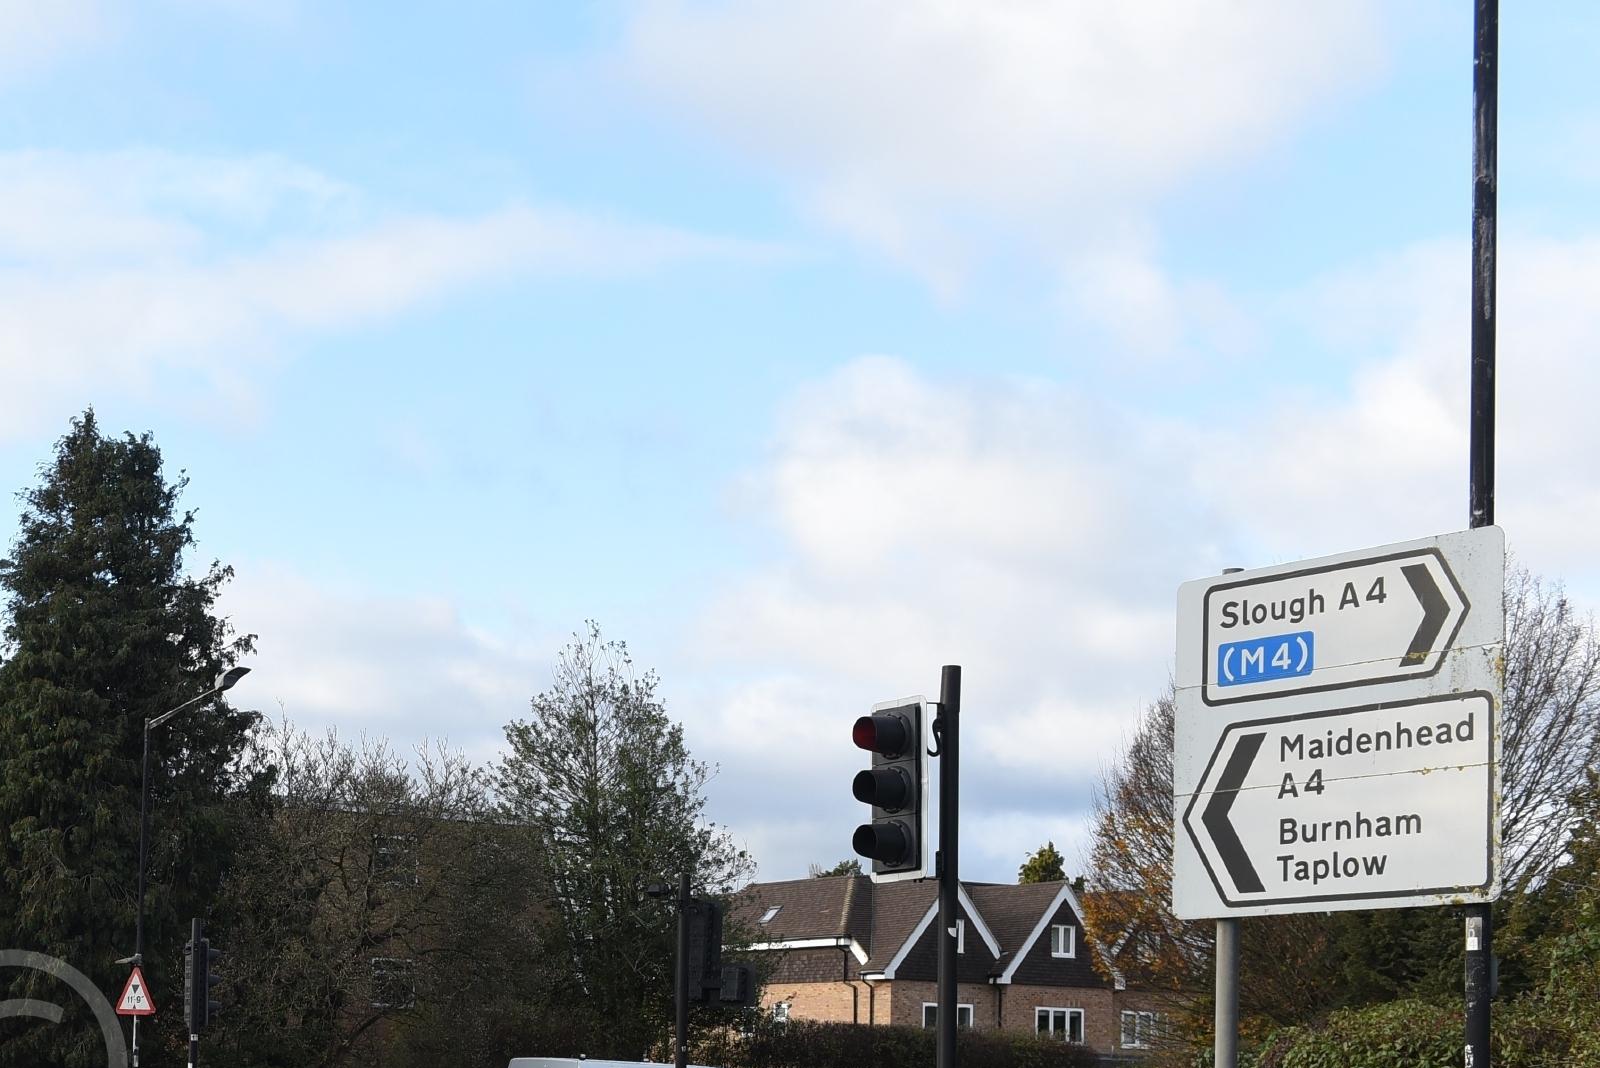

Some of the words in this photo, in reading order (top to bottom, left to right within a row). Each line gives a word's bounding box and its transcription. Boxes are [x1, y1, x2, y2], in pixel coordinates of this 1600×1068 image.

[1220, 588, 1325, 629] Slough
[1339, 576, 1387, 611] A4
[1223, 636, 1308, 682] (M4)
[1280, 712, 1475, 762] Maidenhead
[1277, 769, 1325, 799] A4
[1280, 811, 1422, 845] Burnham
[1276, 852, 1387, 885] Taplow
